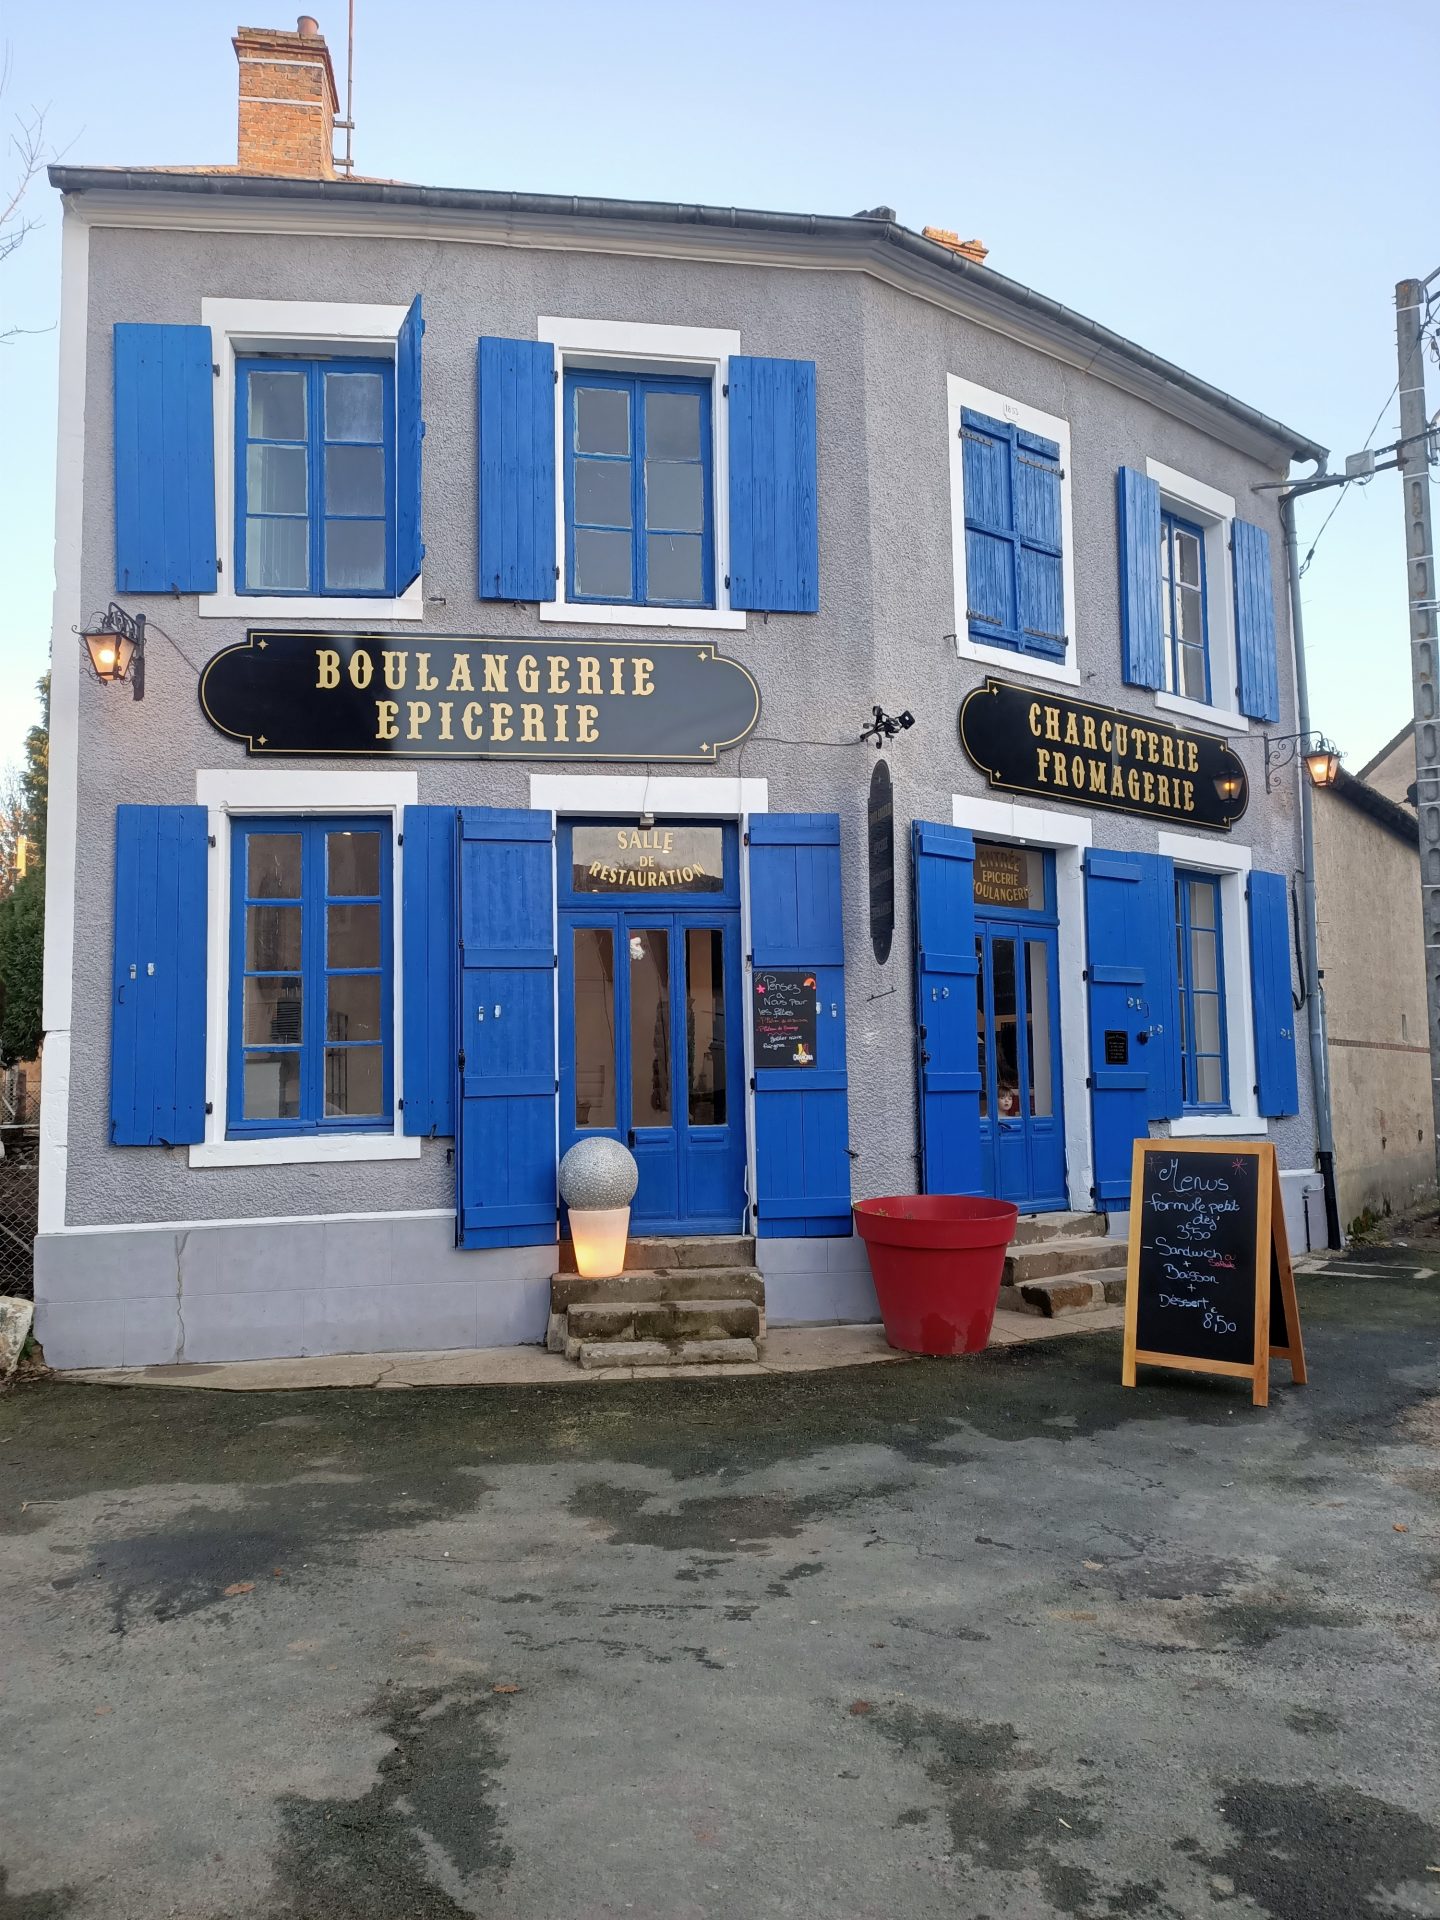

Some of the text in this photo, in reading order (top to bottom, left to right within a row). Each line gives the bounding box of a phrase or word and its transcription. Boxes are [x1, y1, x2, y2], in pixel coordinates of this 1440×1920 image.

[315, 649, 656, 696] BOULANGERIE
[375, 700, 601, 743] EPICERIE
[1028, 702, 1199, 773] CHARCUTERIE
[1036, 748, 1195, 812] FROMAGERIE
[617, 830, 674, 850] SALLE
[588, 860, 706, 887] RESTAURATION
[639, 855, 655, 867] DE
[982, 870, 1019, 886] EPICERIE
[1158, 1158, 1230, 1192] Menus
[1208, 1199, 1240, 1214] petit
[1155, 1236, 1223, 1260] Sandwich
[1162, 1263, 1220, 1284] Boisson
